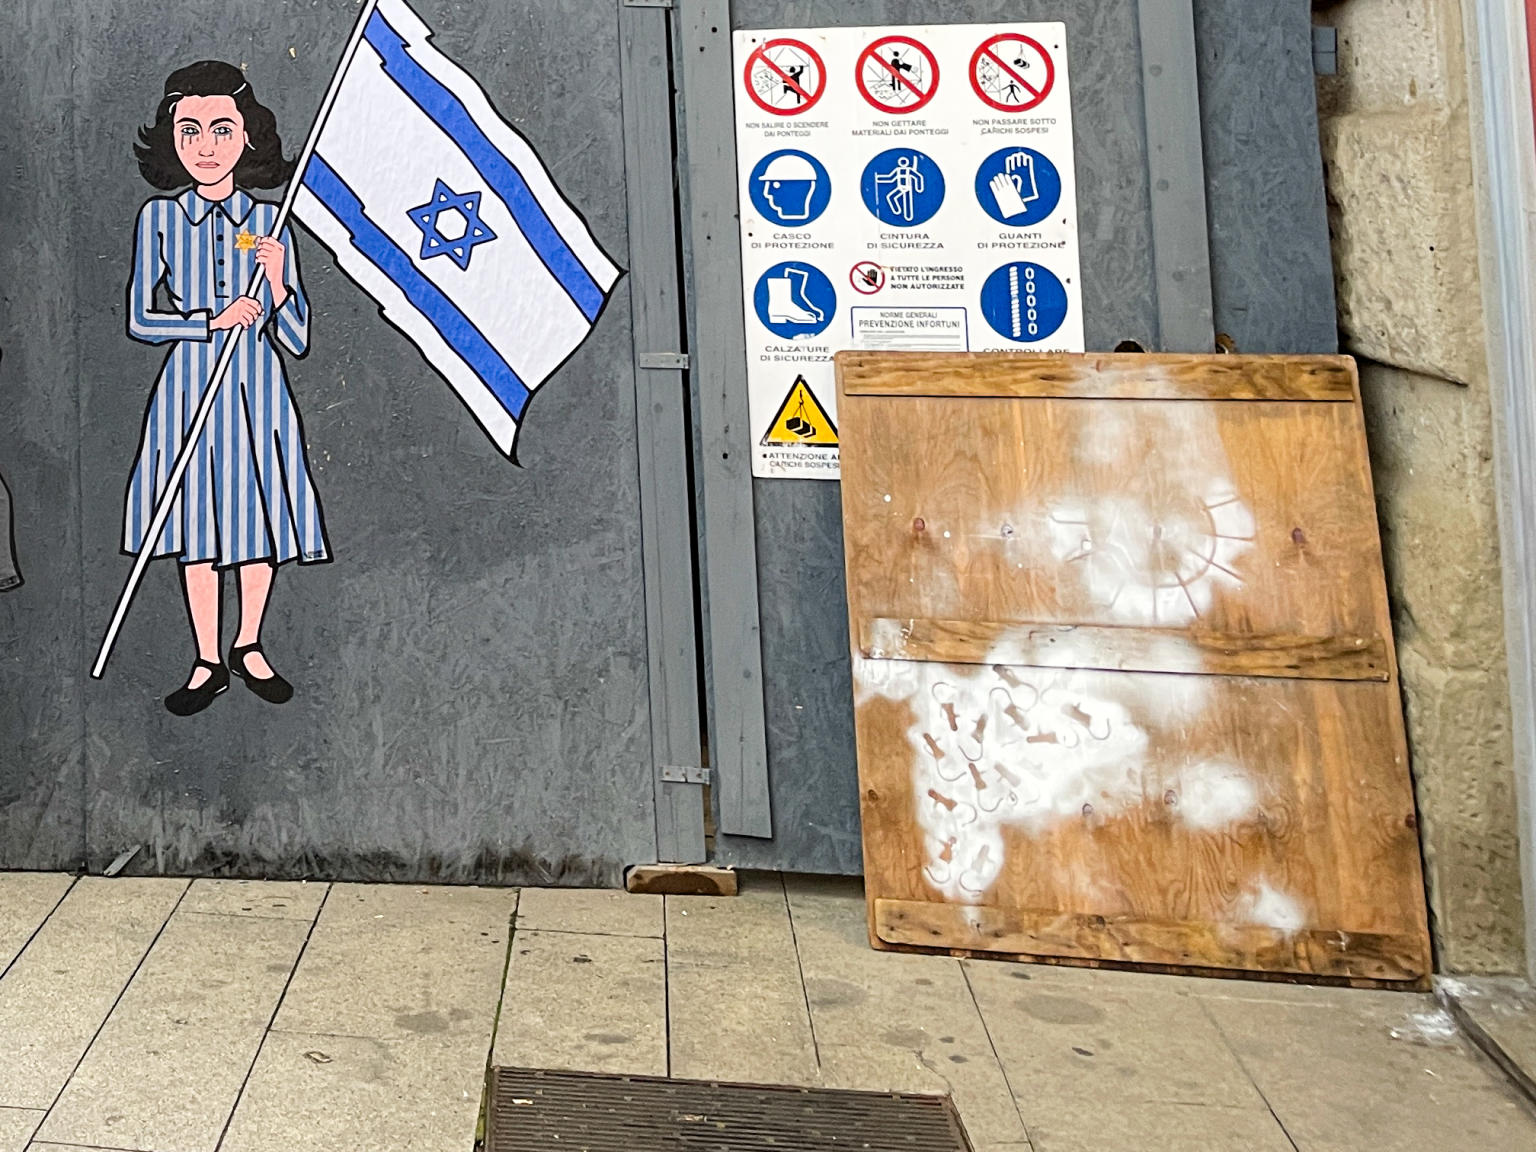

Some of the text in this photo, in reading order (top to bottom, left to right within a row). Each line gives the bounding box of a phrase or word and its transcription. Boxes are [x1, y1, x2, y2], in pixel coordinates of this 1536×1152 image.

[745, 121, 760, 129] NON
[998, 232, 1042, 240] GUANTI
[879, 311, 938, 319] NORME GENERALI
[858, 319, 960, 328] PREVENZIONE INFORTUNI
[764, 345, 830, 353] CALZATURE
[760, 354, 835, 362] DI SICUREZZA
[769, 452, 829, 460] ATTENZIONE
